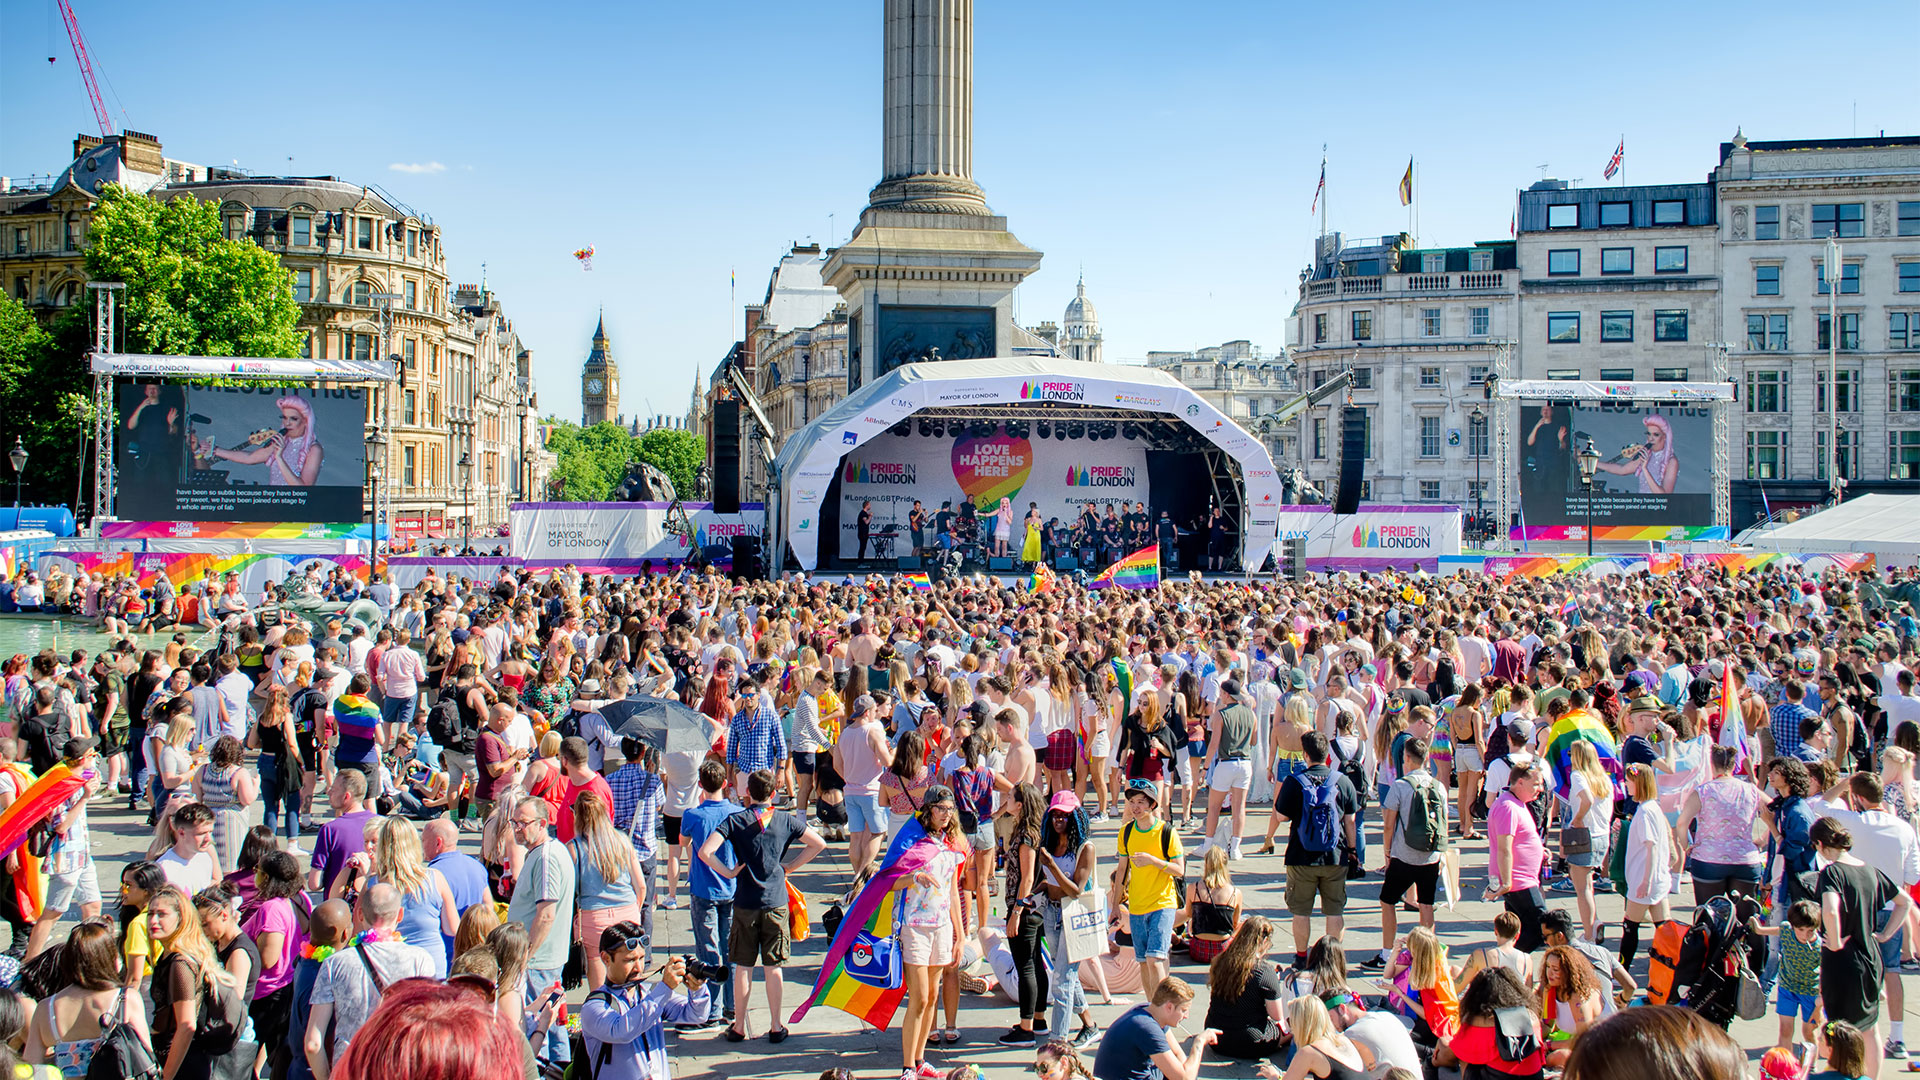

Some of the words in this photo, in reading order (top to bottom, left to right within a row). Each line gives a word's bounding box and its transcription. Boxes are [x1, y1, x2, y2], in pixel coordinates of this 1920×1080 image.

[1754, 154, 1846, 171] CANADIAN
[1043, 382, 1073, 391] PRIDE
[1074, 383, 1085, 392] IN
[1042, 391, 1084, 401] LONDON
[1123, 395, 1162, 407] BARCLAYS
[891, 398, 913, 409] CMS
[974, 444, 1010, 455] LOVE
[959, 454, 1024, 467] HAPPENS
[870, 463, 903, 474] PRIDE
[904, 464, 916, 474] IN
[974, 465, 1009, 477] HERE
[1090, 466, 1122, 477] PRIDE
[1123, 467, 1135, 477] IN
[870, 474, 916, 485] LONDON
[1090, 476, 1135, 487] LONDON
[262, 490, 276, 498] they
[844, 494, 915, 503] #LondonLGBTPride
[281, 498, 297, 506] stage
[298, 498, 307, 506] by
[1065, 497, 1134, 505] #LondonLGBTPride
[708, 523, 746, 536] PRIDE
[747, 523, 760, 536] IN
[842, 523, 858, 531] MAY
[870, 523, 881, 531] OF
[1380, 525, 1416, 537] PRIDE
[1418, 526, 1431, 537] IN
[548, 530, 584, 539] MAYOR
[548, 538, 562, 547] OF
[565, 538, 610, 547] LONDON
[1380, 537, 1431, 549] LONDON
